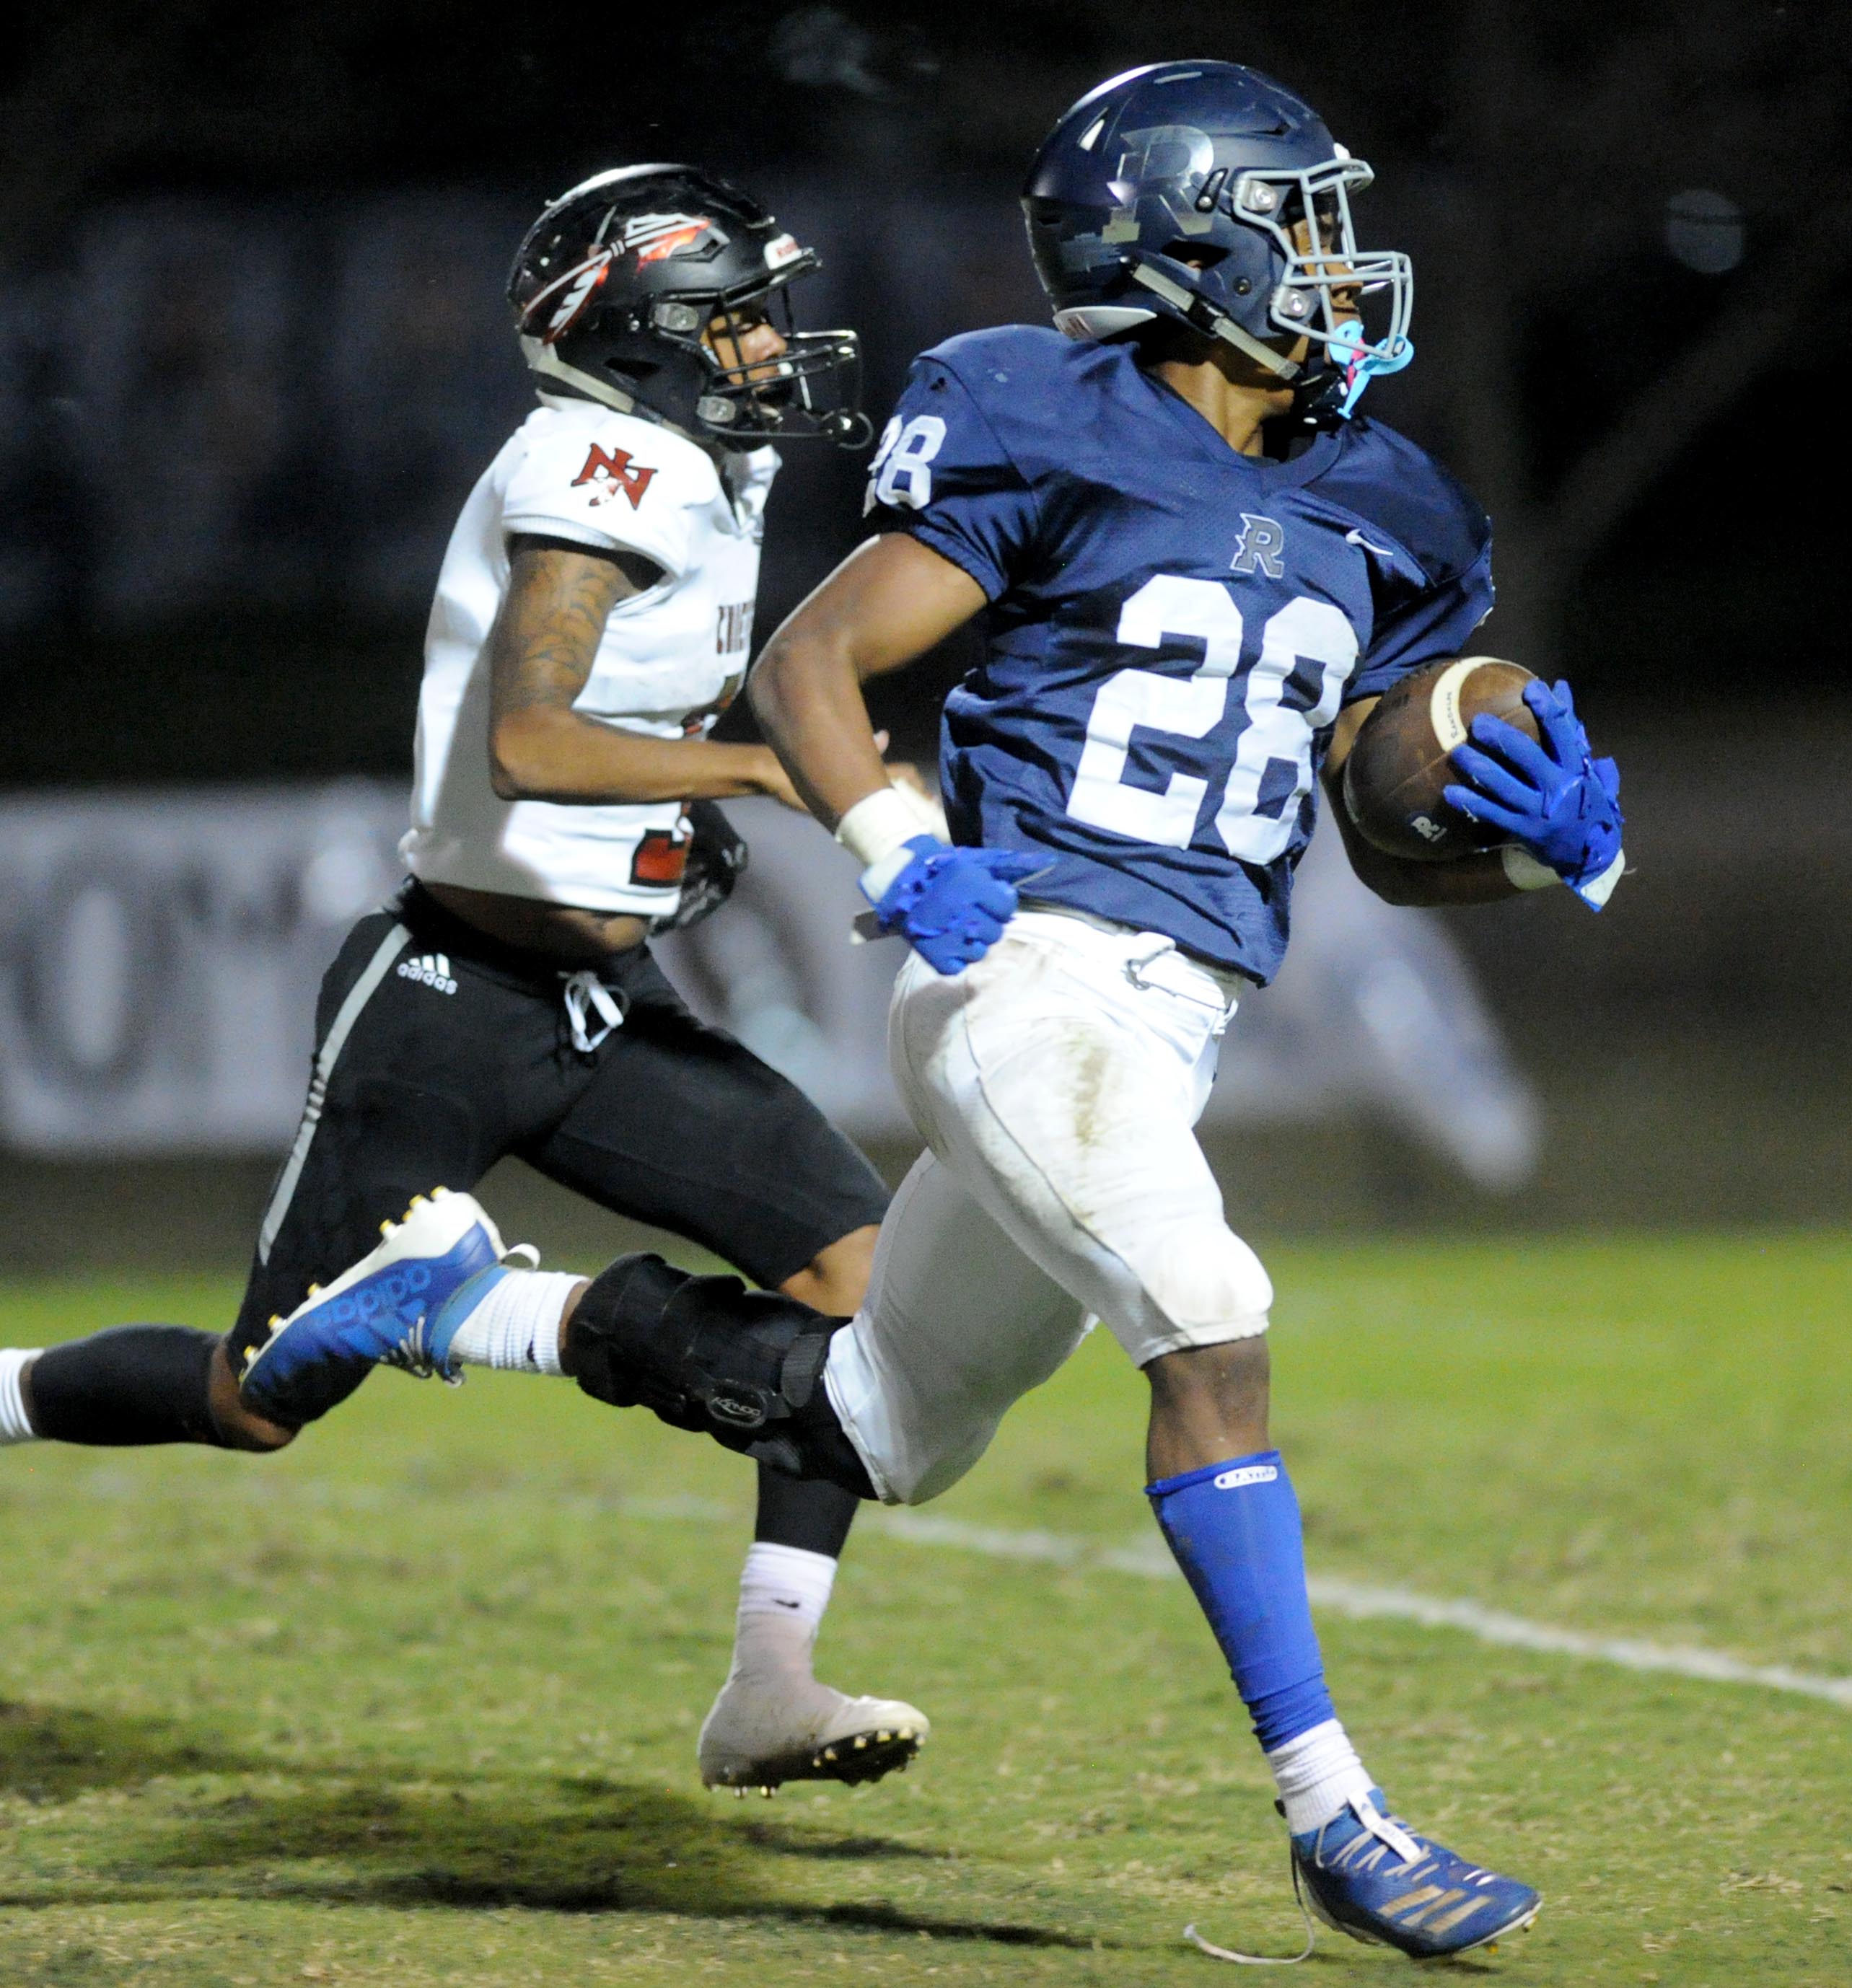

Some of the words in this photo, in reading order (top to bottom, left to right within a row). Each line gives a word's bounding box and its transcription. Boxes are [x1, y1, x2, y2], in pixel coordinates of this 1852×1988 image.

[1230, 513, 1284, 578] R
[1066, 574, 1359, 865] 28
[1411, 816, 1440, 838] R
[396, 962, 458, 995] adidas
